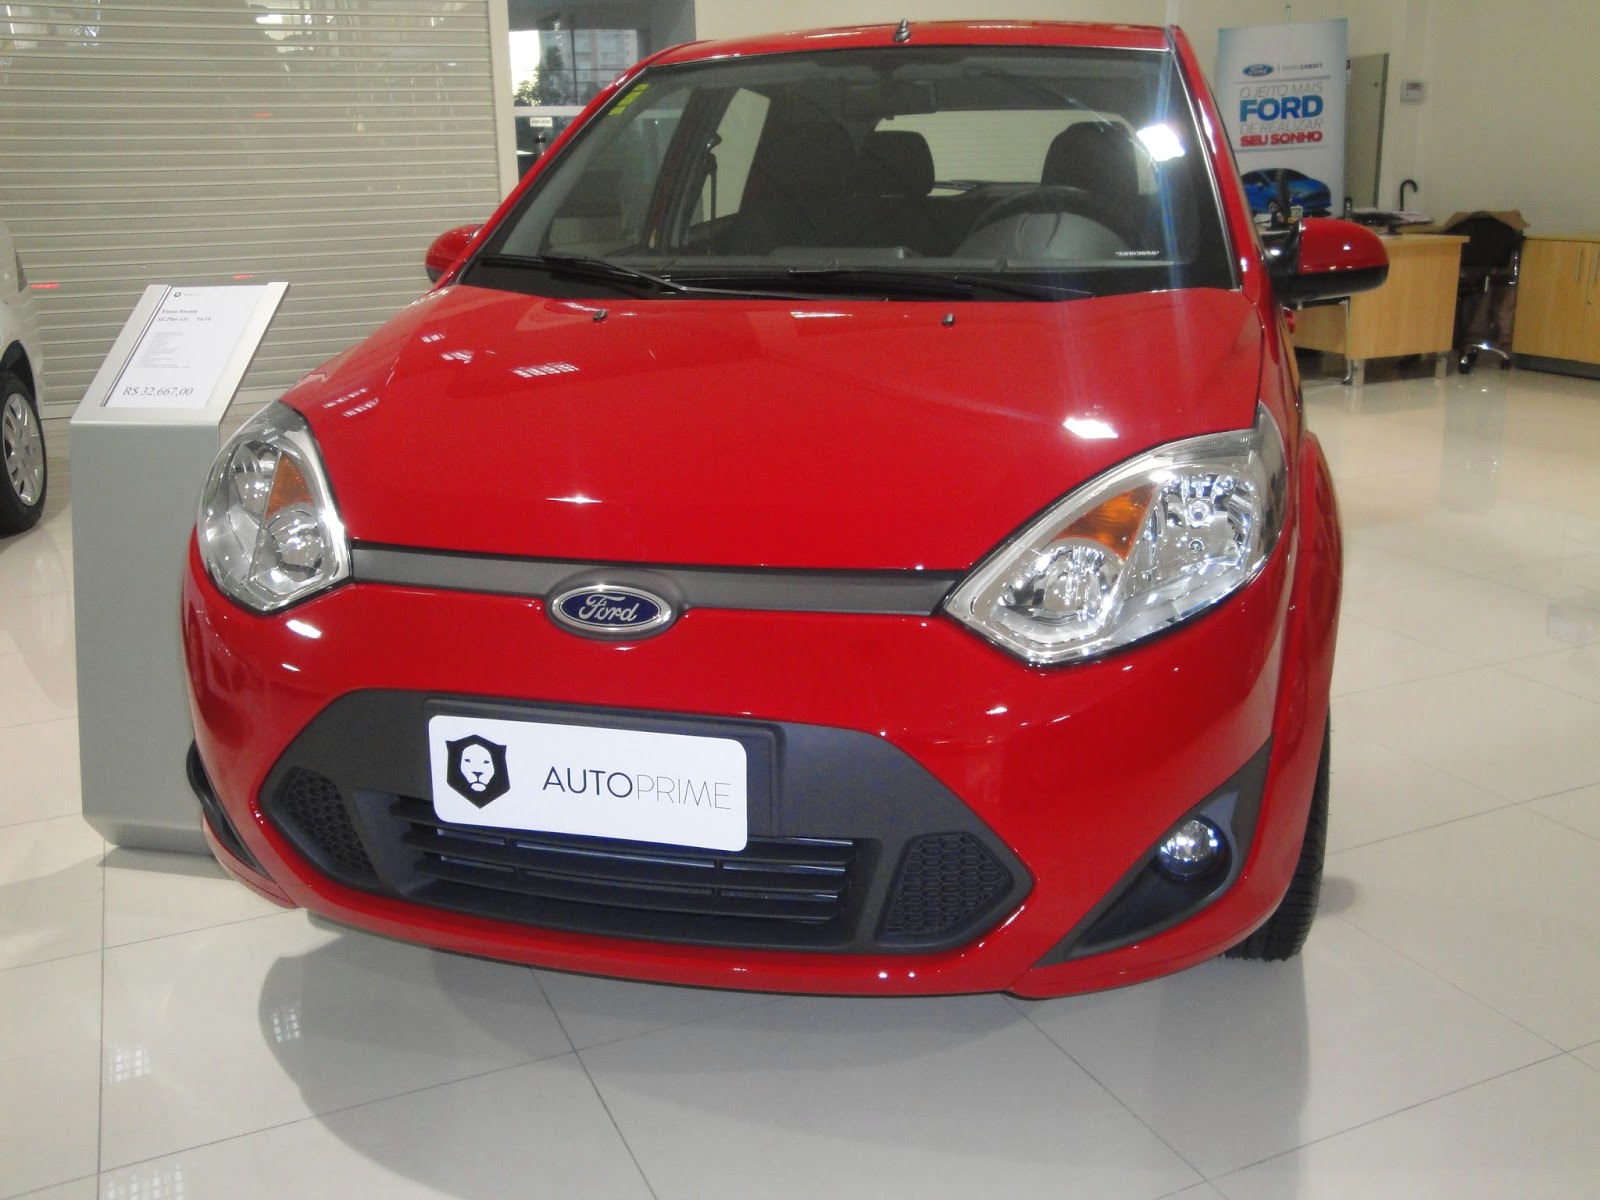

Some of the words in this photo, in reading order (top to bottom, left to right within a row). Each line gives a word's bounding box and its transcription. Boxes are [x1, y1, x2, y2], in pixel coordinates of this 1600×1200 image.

[1240, 87, 1251, 98] O
[1253, 84, 1289, 98] JEITO
[1292, 82, 1324, 97] MAIS
[1240, 95, 1324, 122] FORD
[1240, 123, 1258, 134] DE
[1260, 119, 1324, 133] REALIZAR
[1240, 134, 1269, 147] SEU
[1270, 130, 1323, 146] SONHO
[140, 386, 194, 397] 32.667,00
[578, 594, 640, 622] Ford
[543, 766, 732, 810] AUTOPRIME
